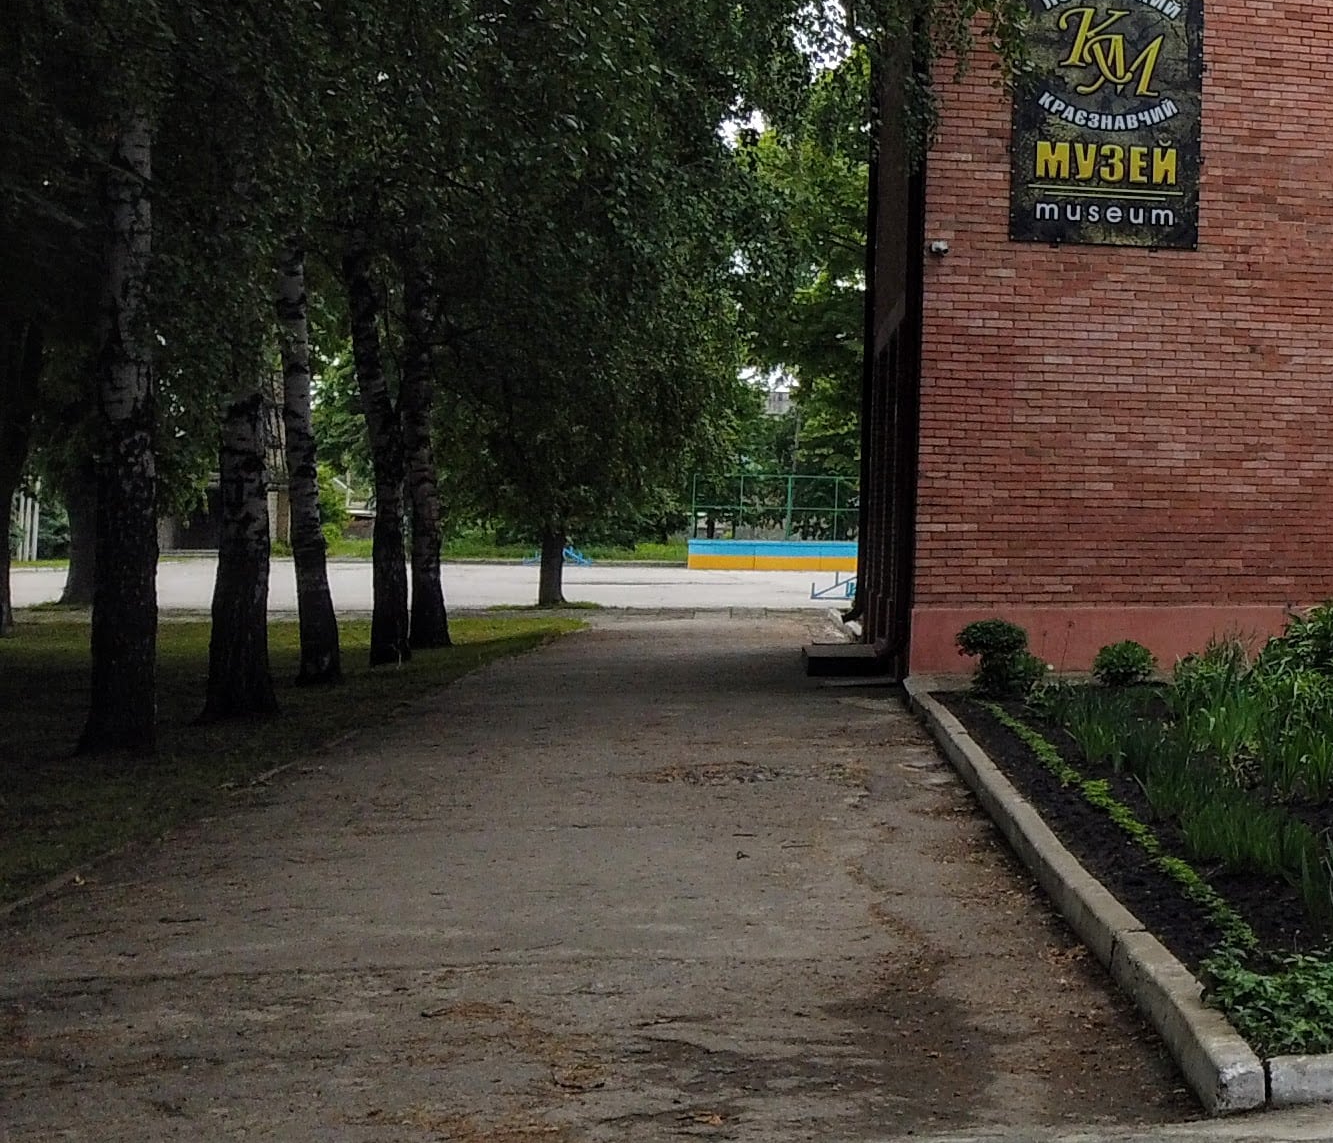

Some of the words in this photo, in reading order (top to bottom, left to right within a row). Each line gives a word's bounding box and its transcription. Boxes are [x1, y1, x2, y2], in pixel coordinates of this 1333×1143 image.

[1038, 90, 1179, 131] КРАЄЗНАВЧИЙ
[1035, 140, 1177, 186] МУЗЕЙ
[1035, 202, 1175, 226] museum
